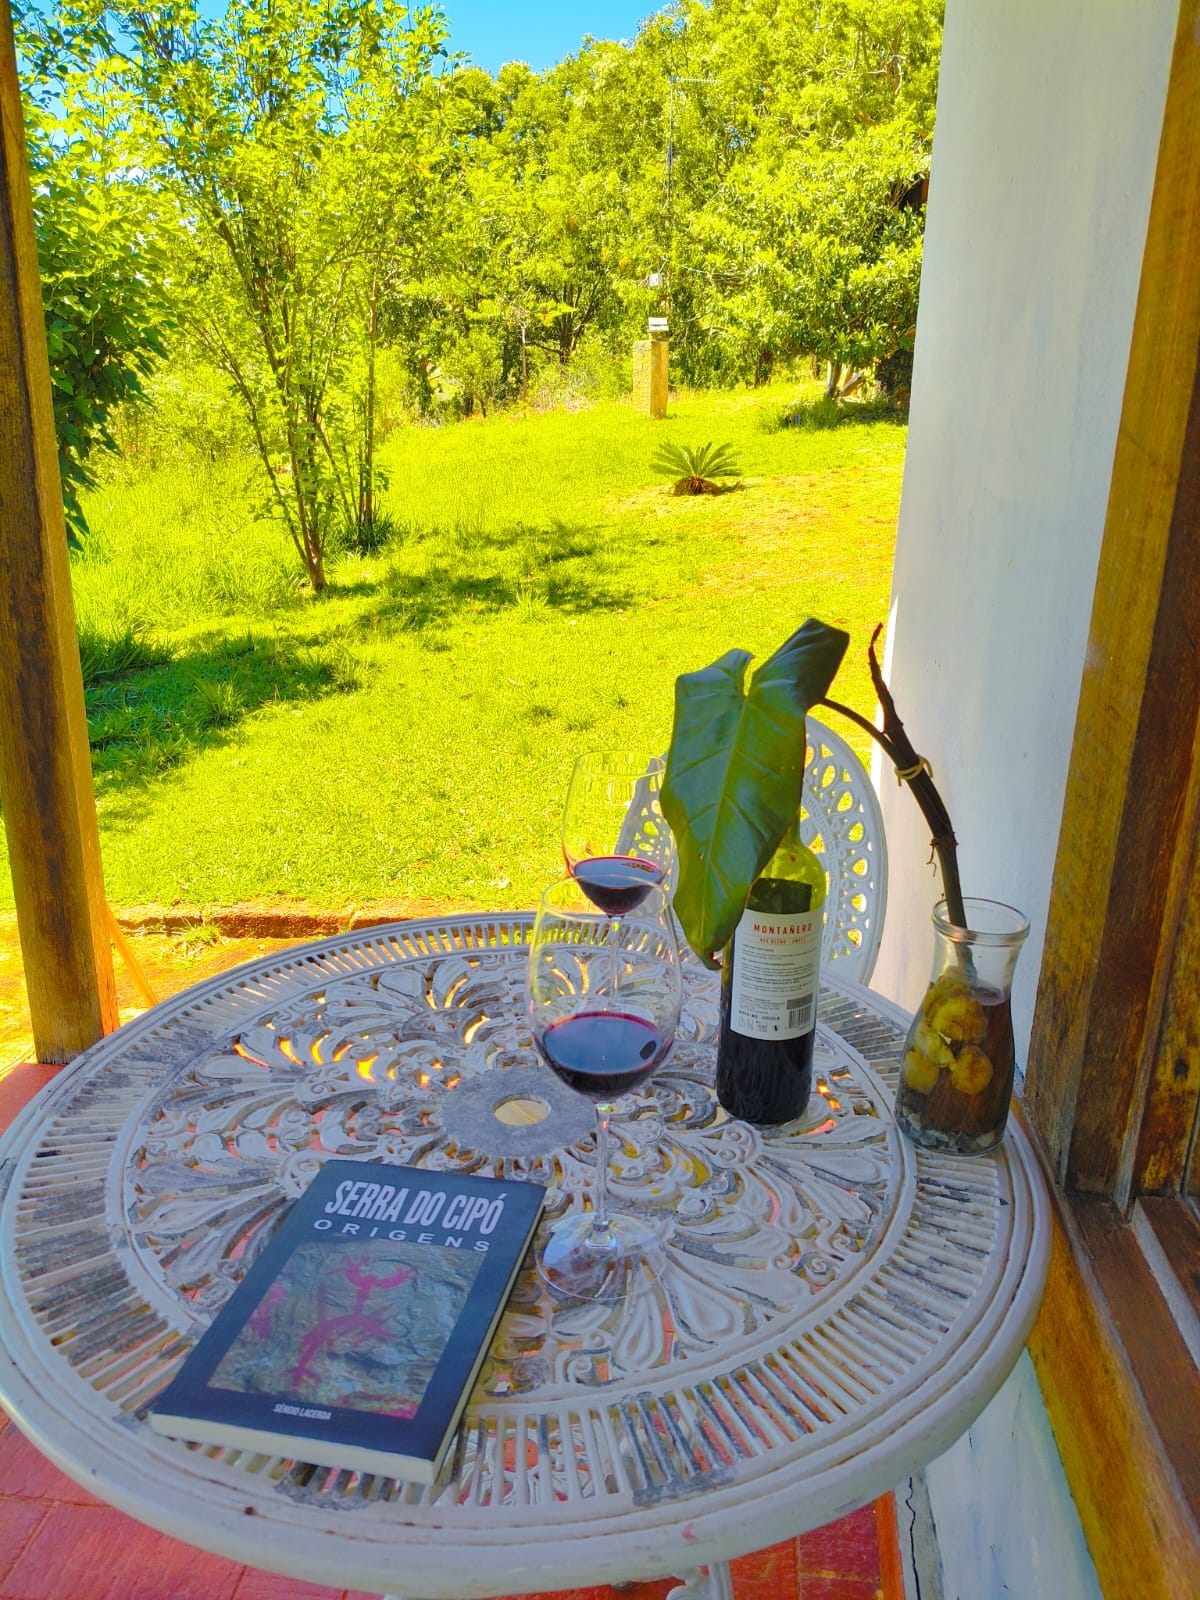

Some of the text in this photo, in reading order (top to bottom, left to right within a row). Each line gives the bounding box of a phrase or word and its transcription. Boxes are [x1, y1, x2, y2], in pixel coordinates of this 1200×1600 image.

[326, 1180, 508, 1236] SERRA DO CIPÓ
[313, 1219, 491, 1252] ORIGENS
